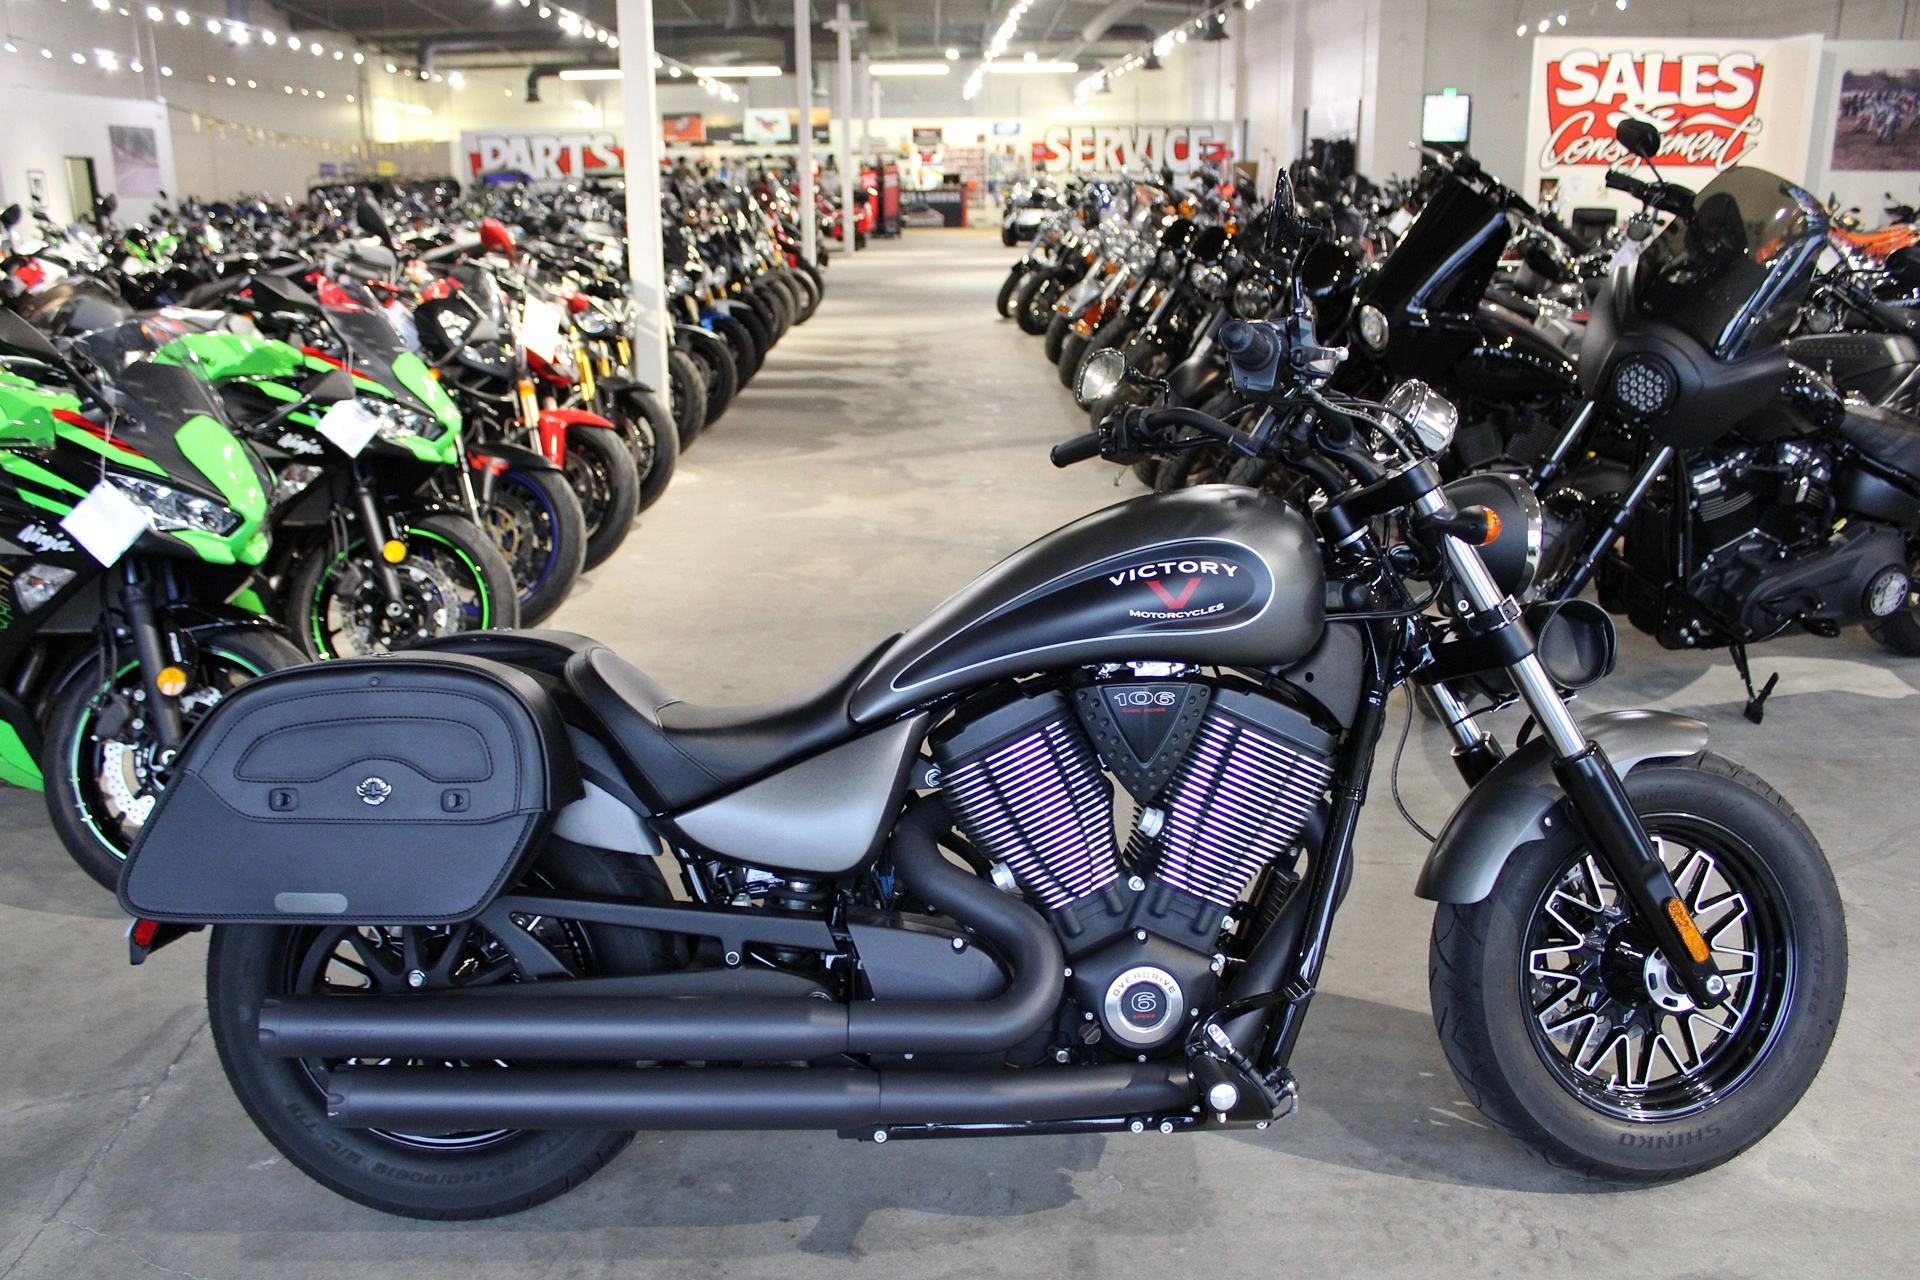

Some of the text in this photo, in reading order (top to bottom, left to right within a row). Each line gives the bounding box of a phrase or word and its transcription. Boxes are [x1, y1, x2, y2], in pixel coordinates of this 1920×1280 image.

[1555, 50, 1756, 110] SALES
[477, 132, 621, 183] PARTS
[1044, 124, 1214, 175] SERVICE
[1108, 560, 1238, 587] VICTORY
[1129, 602, 1226, 620] MOTORCYCLES
[1113, 691, 1176, 707] 106
[1112, 971, 1177, 997] OVERDRIVE
[1131, 991, 1157, 1013] 6
[1620, 1121, 1722, 1149] SHINKO
